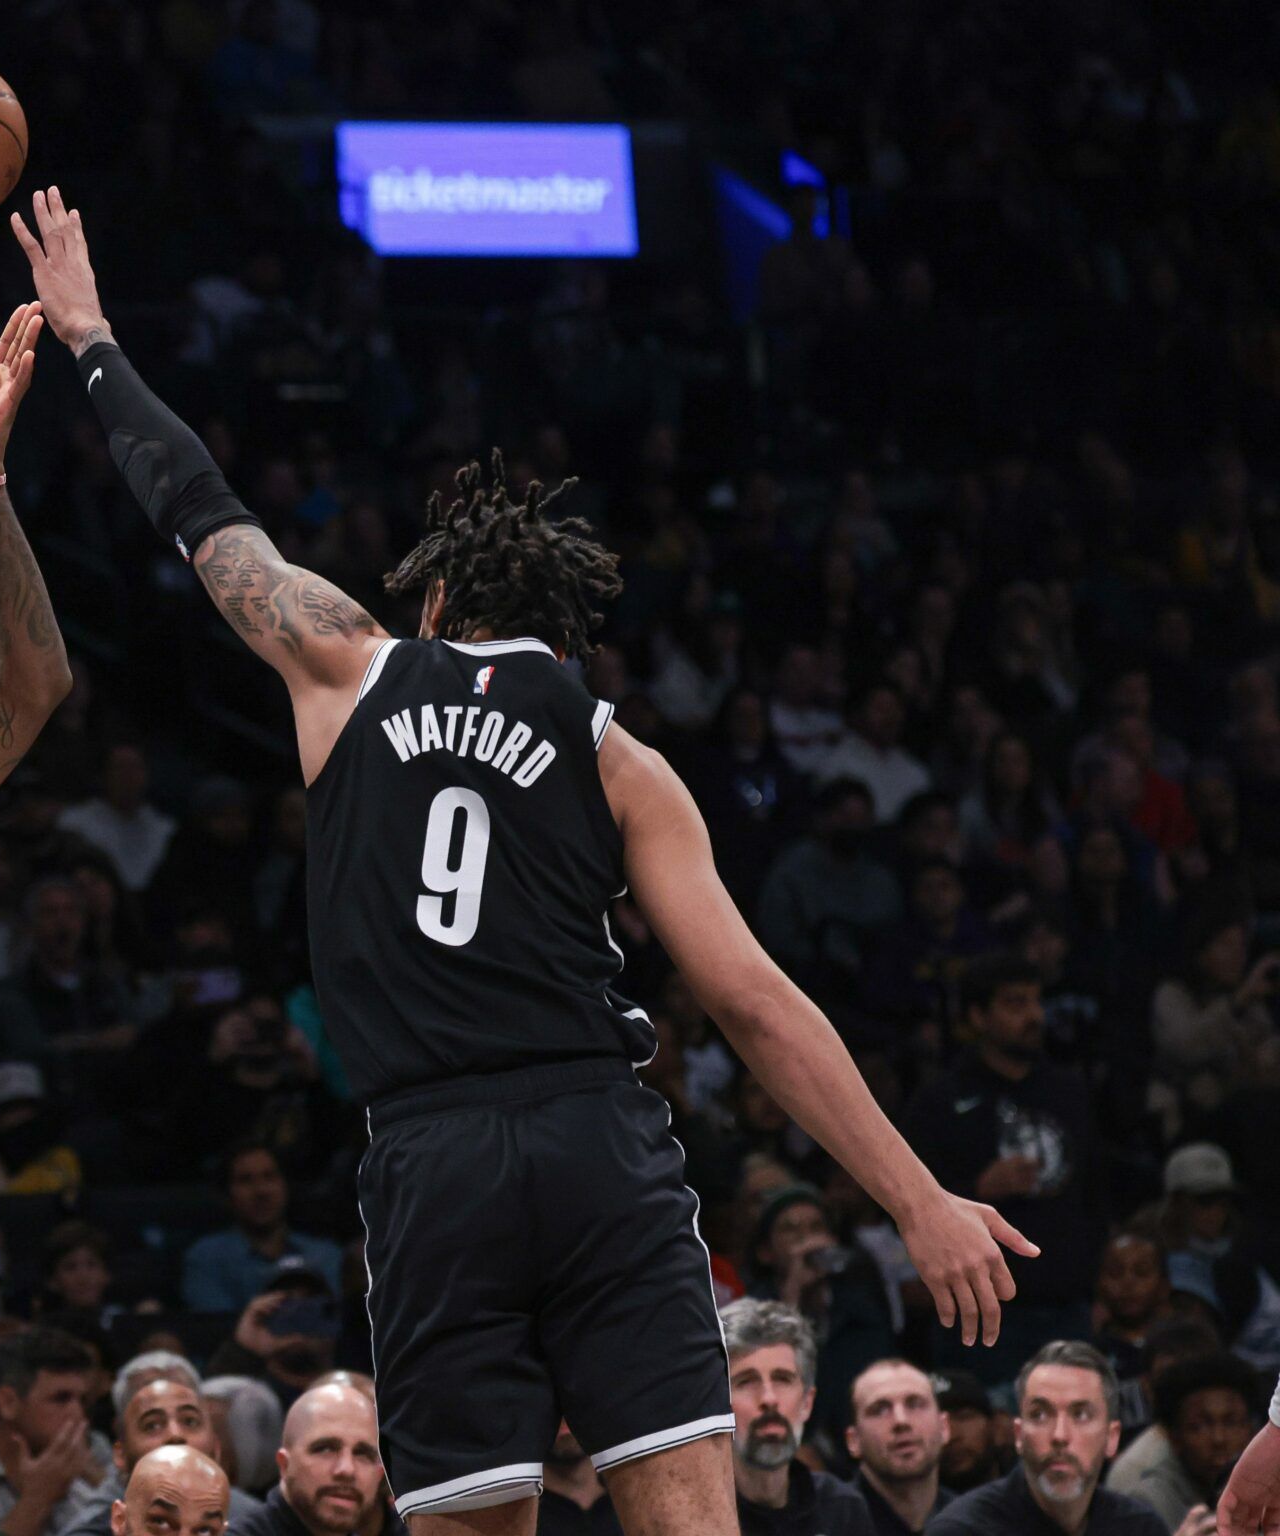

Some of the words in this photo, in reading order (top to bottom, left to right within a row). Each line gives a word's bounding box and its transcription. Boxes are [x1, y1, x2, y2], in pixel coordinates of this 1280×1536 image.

[370, 166, 612, 214] ticketmaster
[211, 563, 232, 591] the
[224, 595, 264, 638] limit
[381, 703, 557, 788] WATFORD
[416, 786, 491, 947] 9
